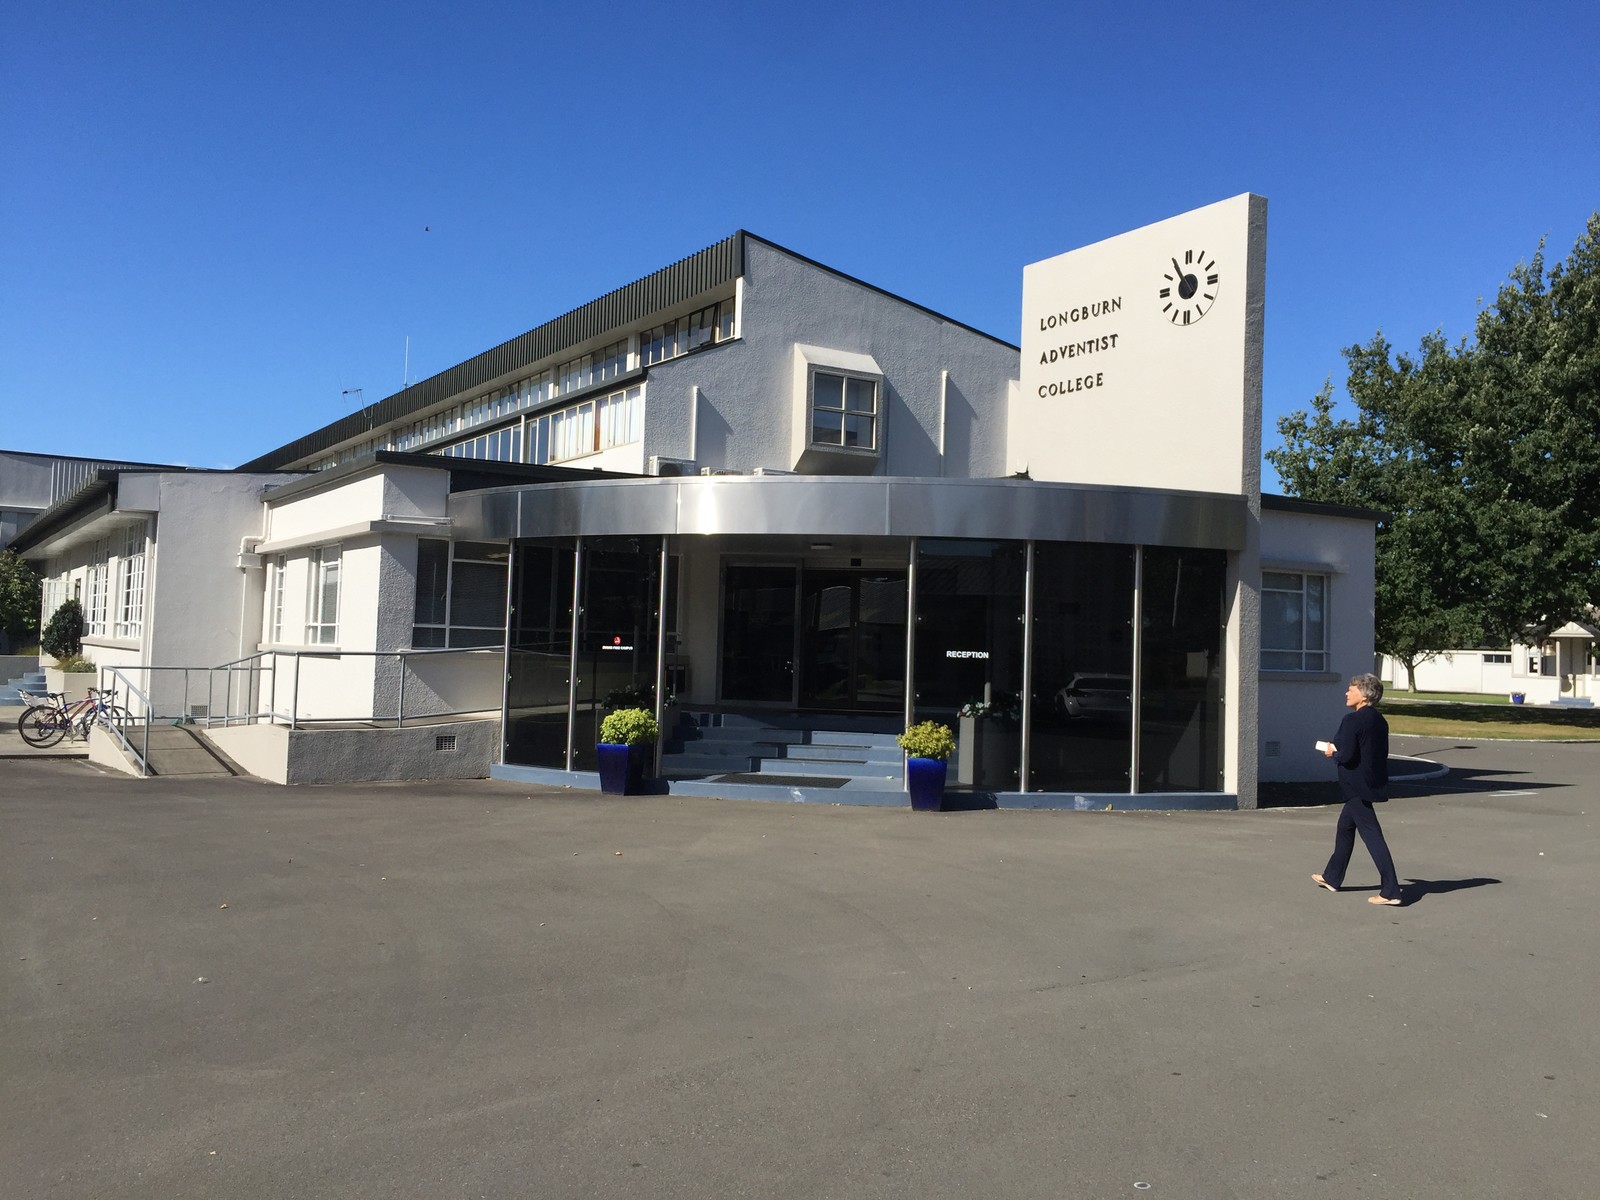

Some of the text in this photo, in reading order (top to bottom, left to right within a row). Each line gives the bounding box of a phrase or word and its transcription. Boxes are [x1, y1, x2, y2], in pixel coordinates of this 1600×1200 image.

[1040, 296, 1122, 331] LONGBURN
[1039, 333, 1119, 365] ADVENTIST
[1038, 372, 1104, 398] COLLEGE
[946, 650, 990, 659] RECEPTION
